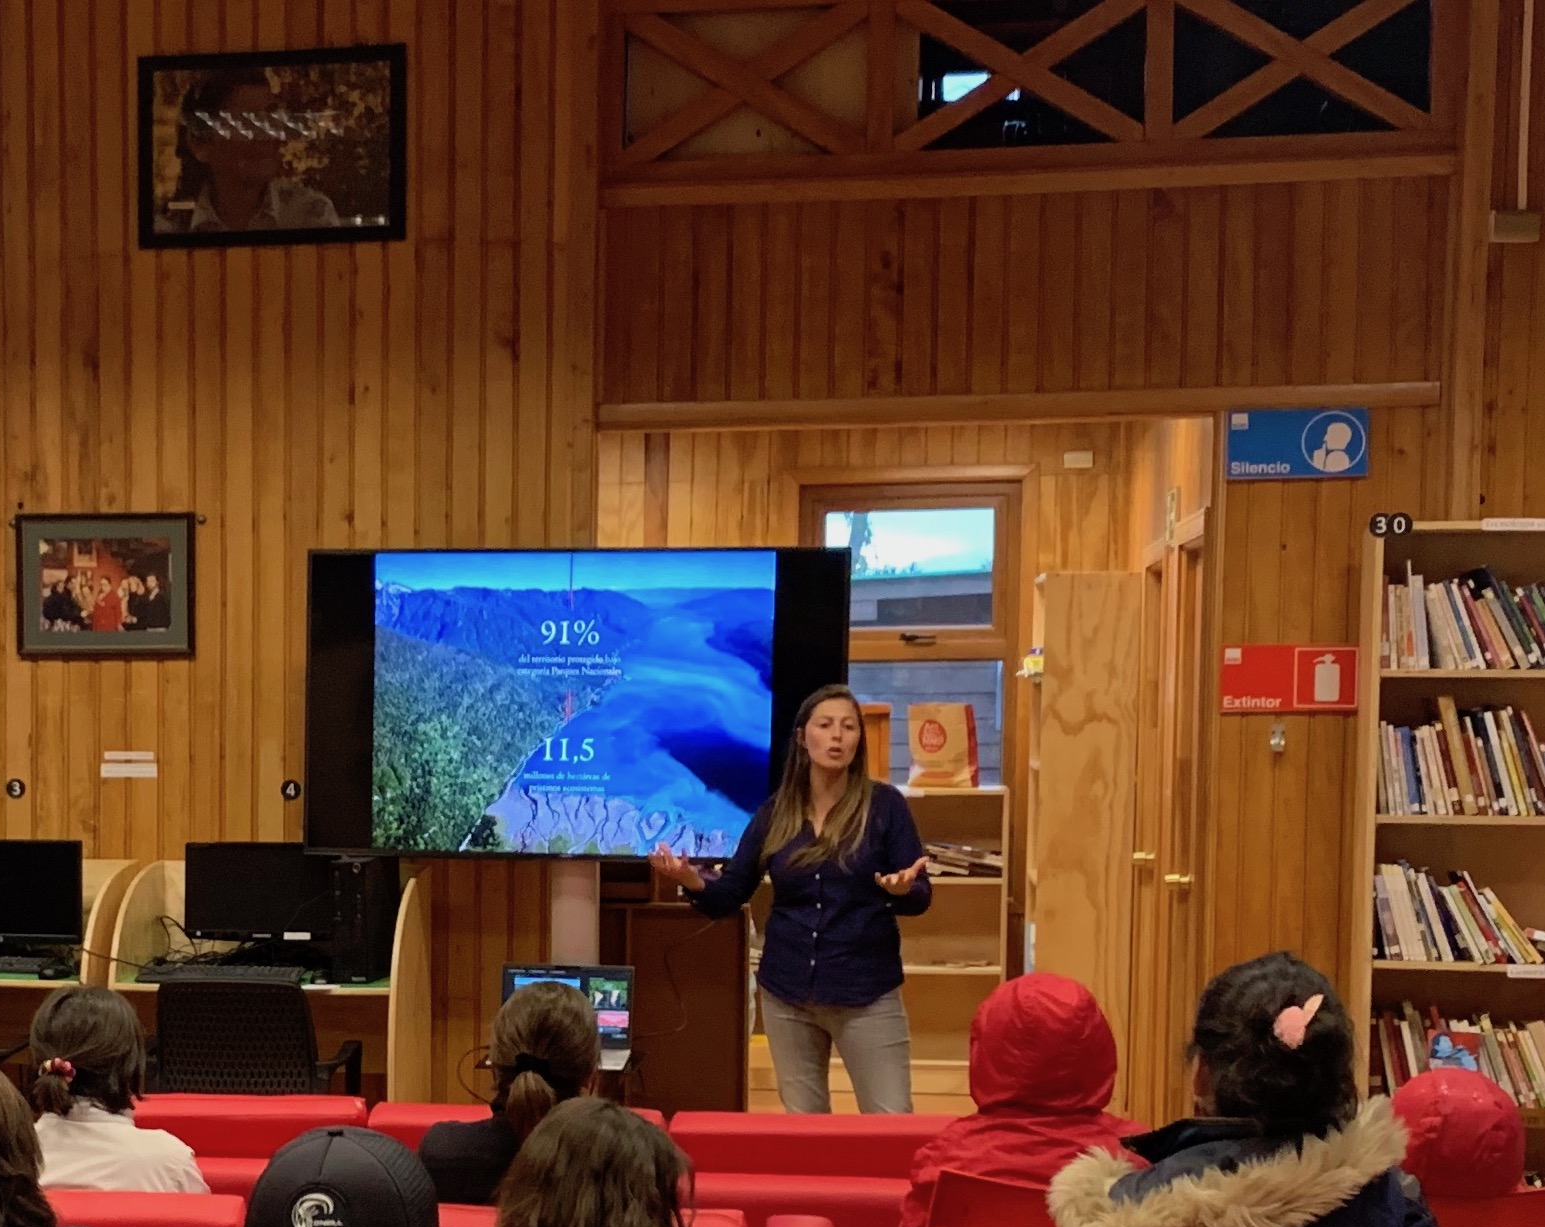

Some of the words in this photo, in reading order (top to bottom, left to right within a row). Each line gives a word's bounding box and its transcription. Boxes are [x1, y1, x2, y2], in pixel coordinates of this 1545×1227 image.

[1230, 461, 1291, 475] Silencio
[1374, 515, 1406, 534] 30
[540, 619, 600, 646] 91%
[518, 653, 531, 664] del
[581, 666, 622, 676] Nacionales
[1222, 695, 1282, 709] Extintor
[555, 770, 566, 780] de
[11, 781, 22, 796] 3
[285, 782, 296, 797] 4
